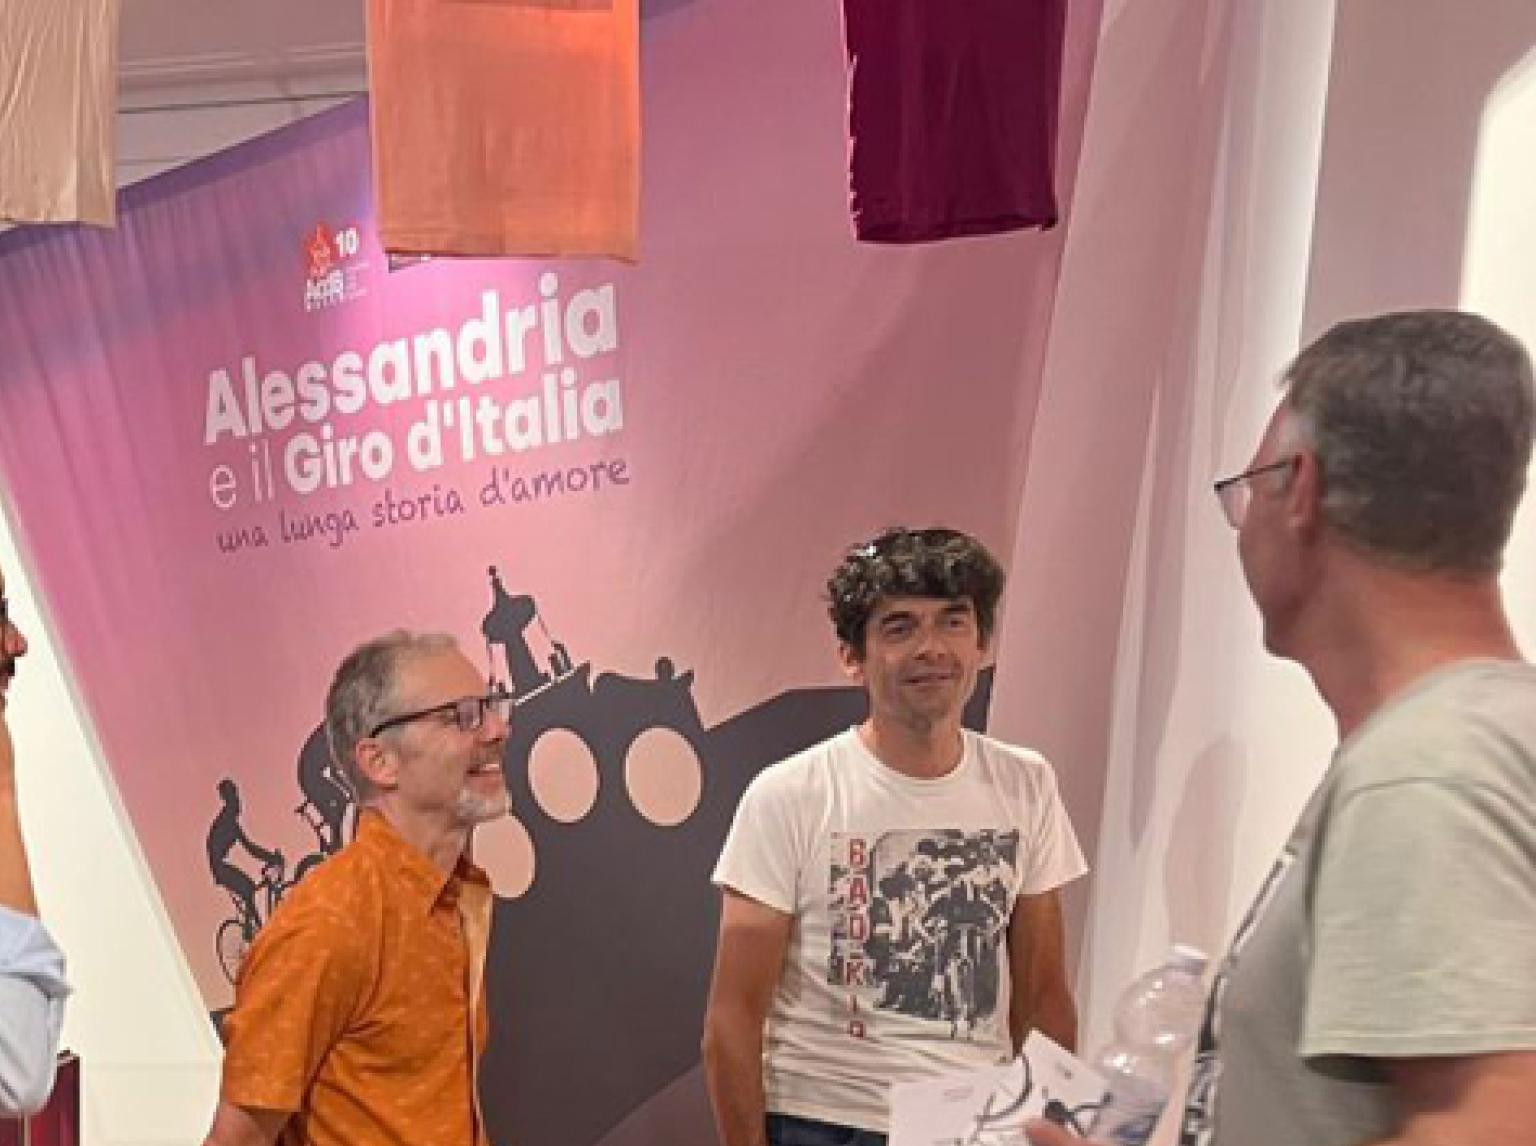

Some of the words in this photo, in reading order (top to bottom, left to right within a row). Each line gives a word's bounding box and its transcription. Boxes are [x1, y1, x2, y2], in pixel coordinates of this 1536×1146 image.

[333, 226, 359, 258] 10
[203, 272, 619, 446] Alessandria
[210, 464, 237, 510] e
[248, 438, 275, 503] il
[283, 424, 394, 495] Giro
[407, 367, 625, 473] d'Italia
[217, 524, 269, 554] una
[279, 509, 360, 548] lunga
[372, 484, 465, 528] storia
[480, 457, 631, 509] d'amore
